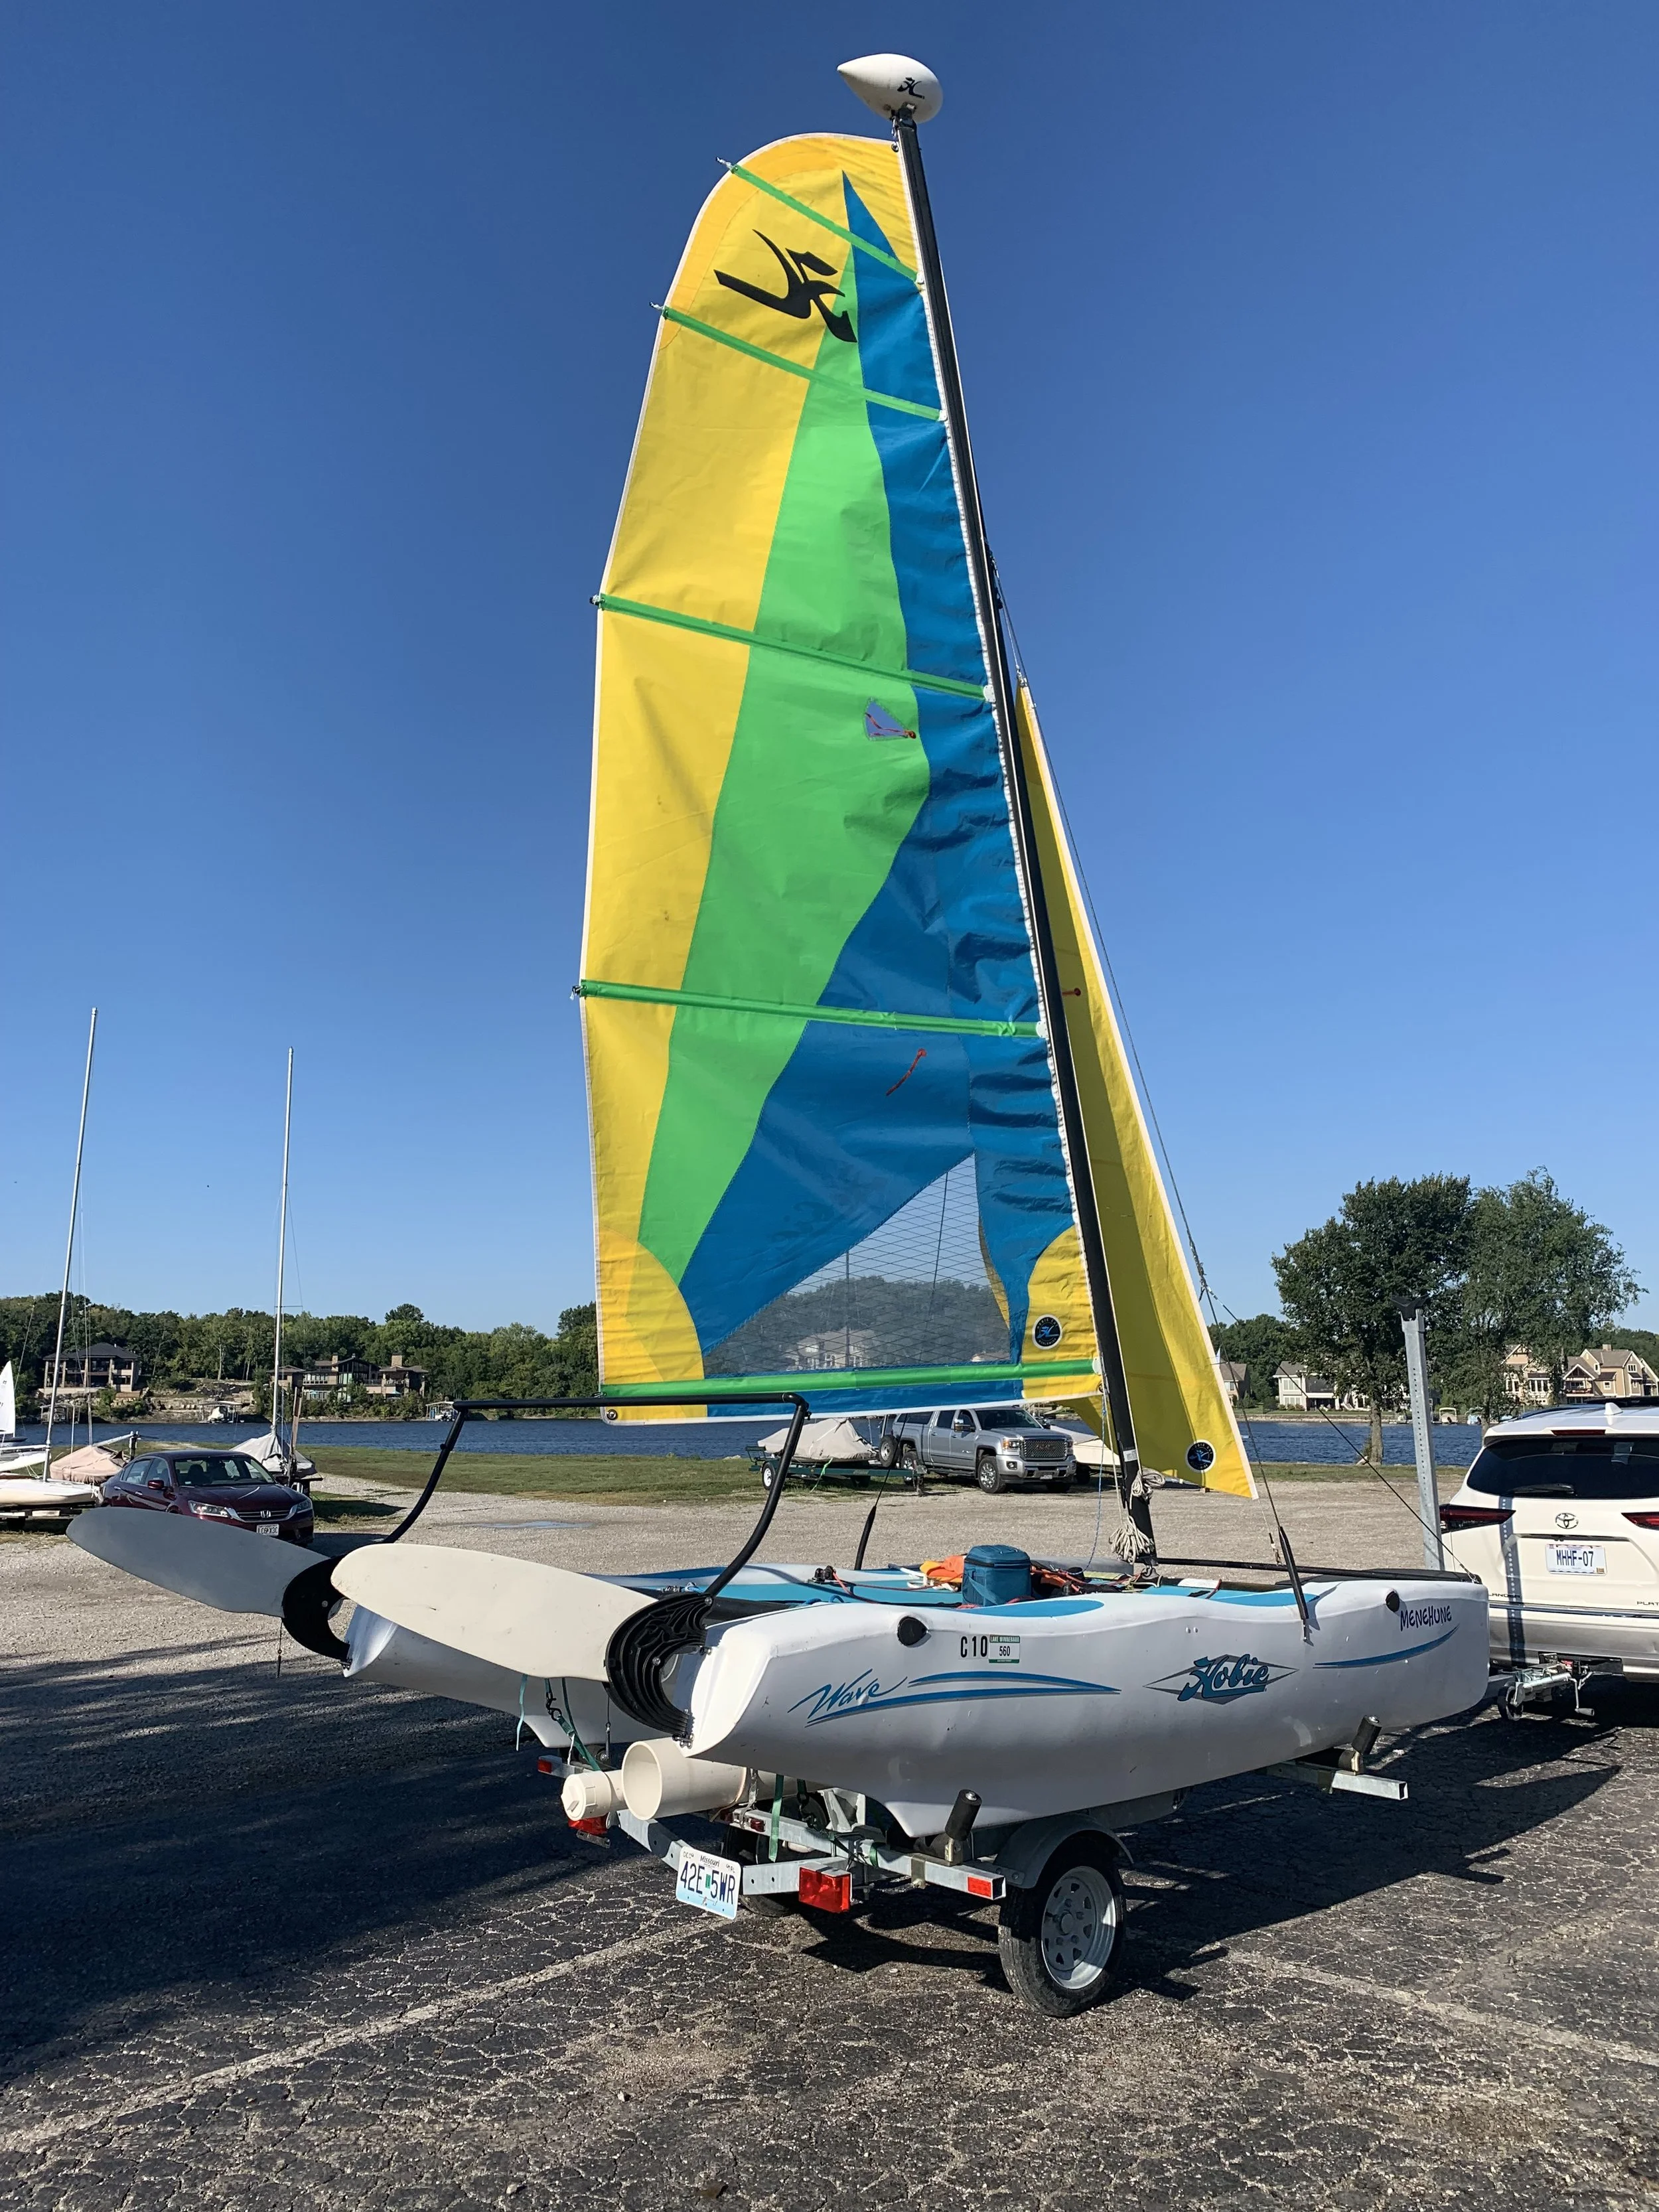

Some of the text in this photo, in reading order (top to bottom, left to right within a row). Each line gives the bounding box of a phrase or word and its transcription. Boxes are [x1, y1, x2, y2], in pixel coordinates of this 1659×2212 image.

[1556, 1550, 1593, 1567] MHHF-07
[1400, 1605, 1452, 1631] MENEHUNE
[999, 1646, 1011, 1657] 560
[1177, 1654, 1270, 1702] Hobie
[787, 1668, 908, 1720] Wave
[699, 1856, 721, 1868] Missouri
[680, 1861, 736, 1905] 42E 5WR
